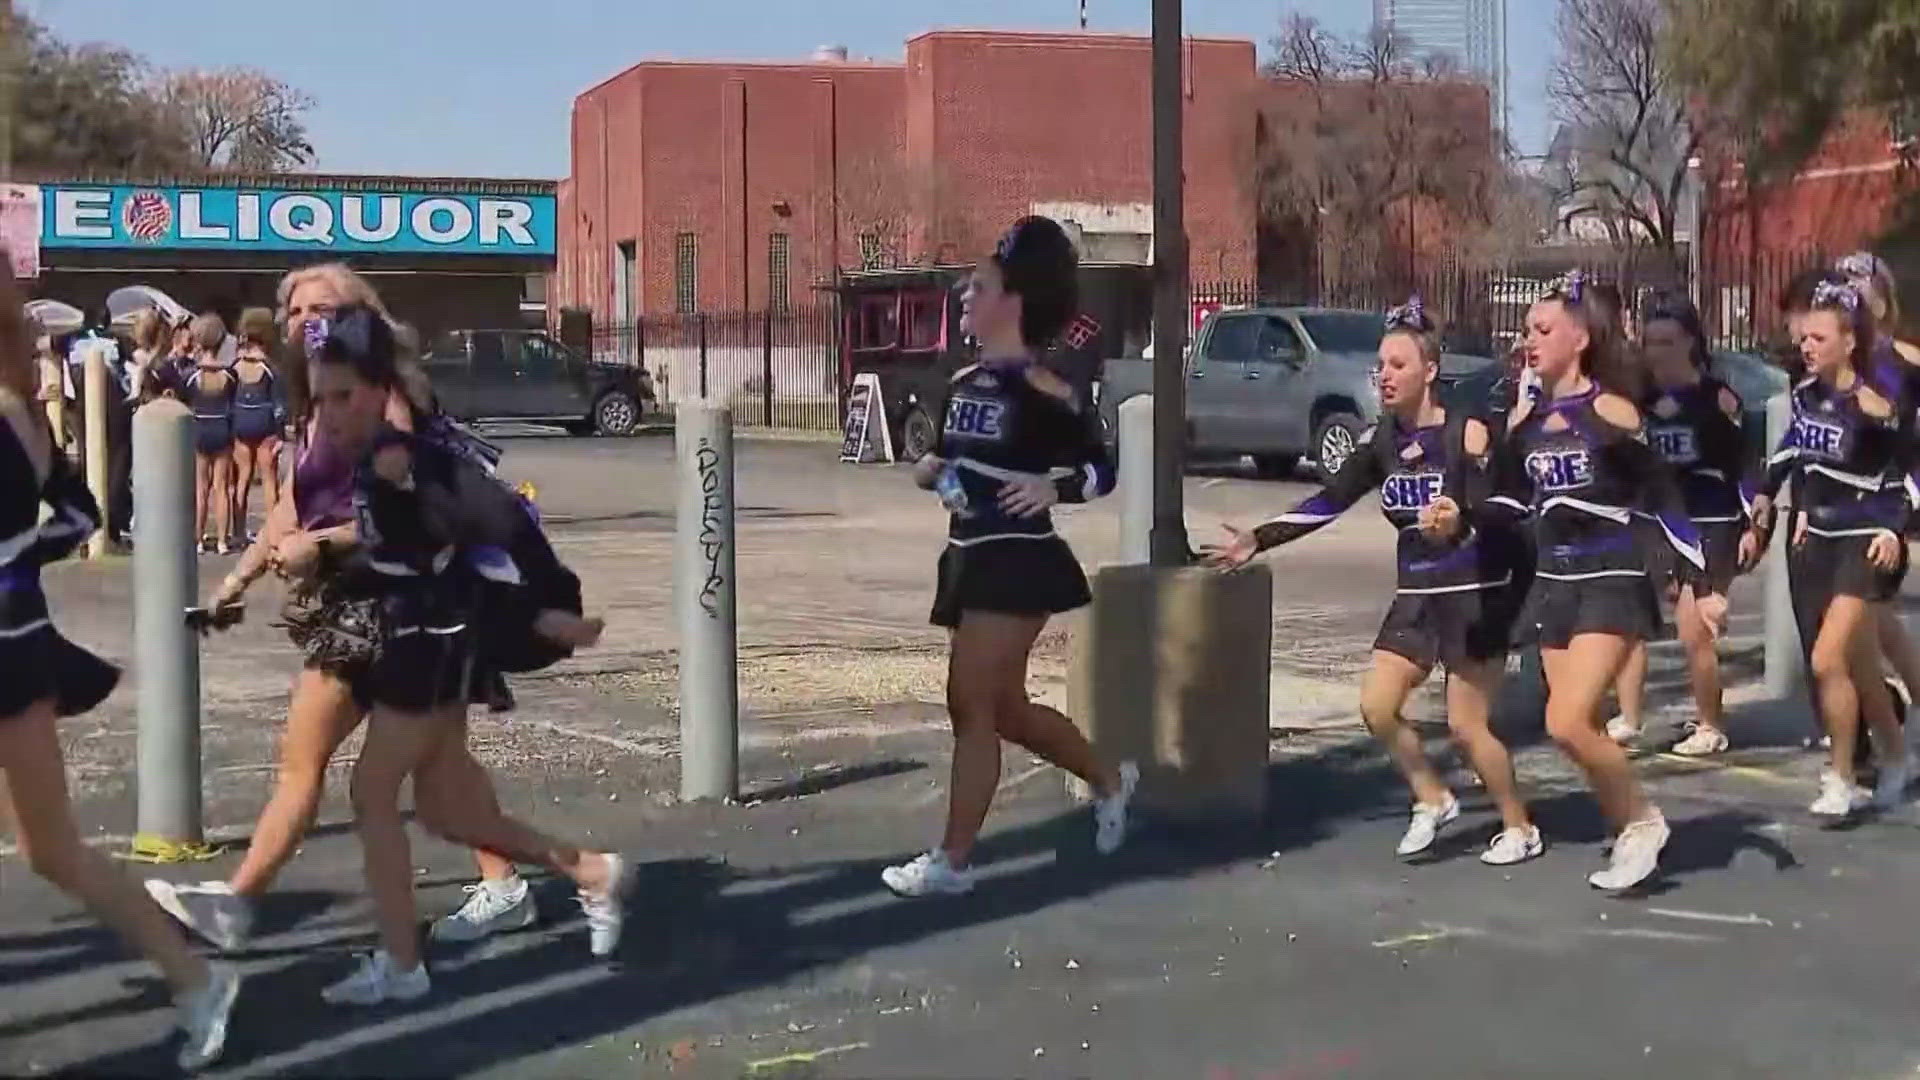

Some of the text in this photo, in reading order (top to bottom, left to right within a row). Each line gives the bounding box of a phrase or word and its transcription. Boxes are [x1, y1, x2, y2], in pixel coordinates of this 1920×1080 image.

[39, 190, 537, 246] E LIQUOR
[1380, 472, 1443, 511] SBE
